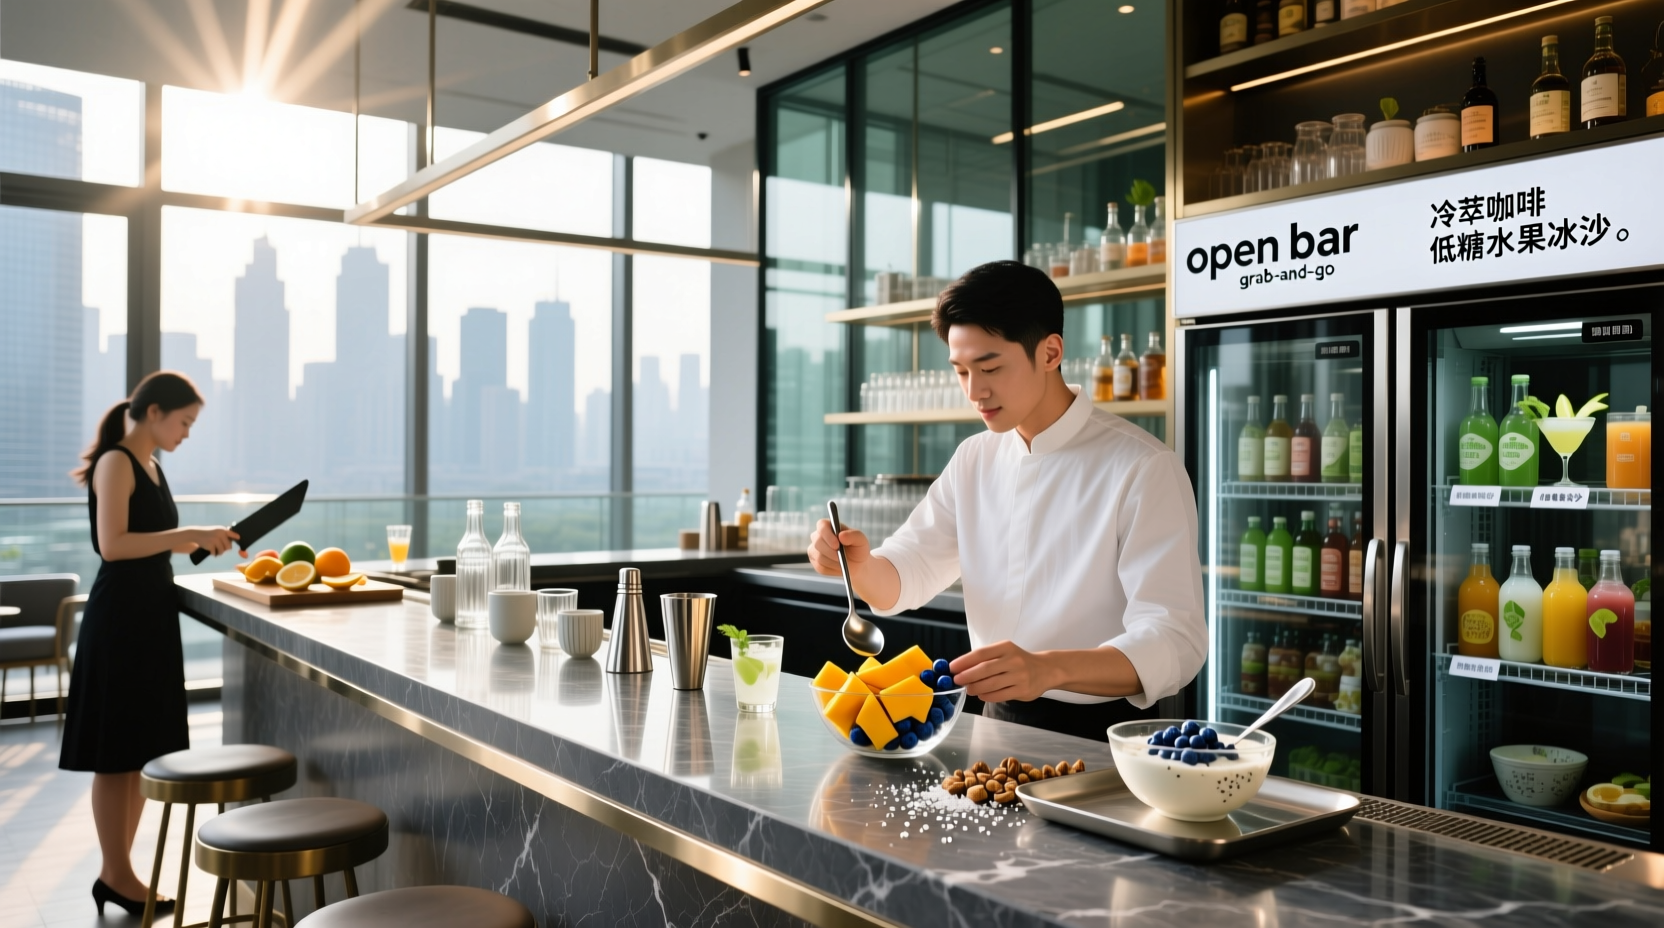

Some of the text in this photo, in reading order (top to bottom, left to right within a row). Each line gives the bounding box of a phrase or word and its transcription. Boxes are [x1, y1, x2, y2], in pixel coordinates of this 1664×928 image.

[1430, 186, 1546, 229] 冷萃咖啡
[1186, 222, 1359, 281] open bar
[1239, 263, 1335, 290] grab-and-go
